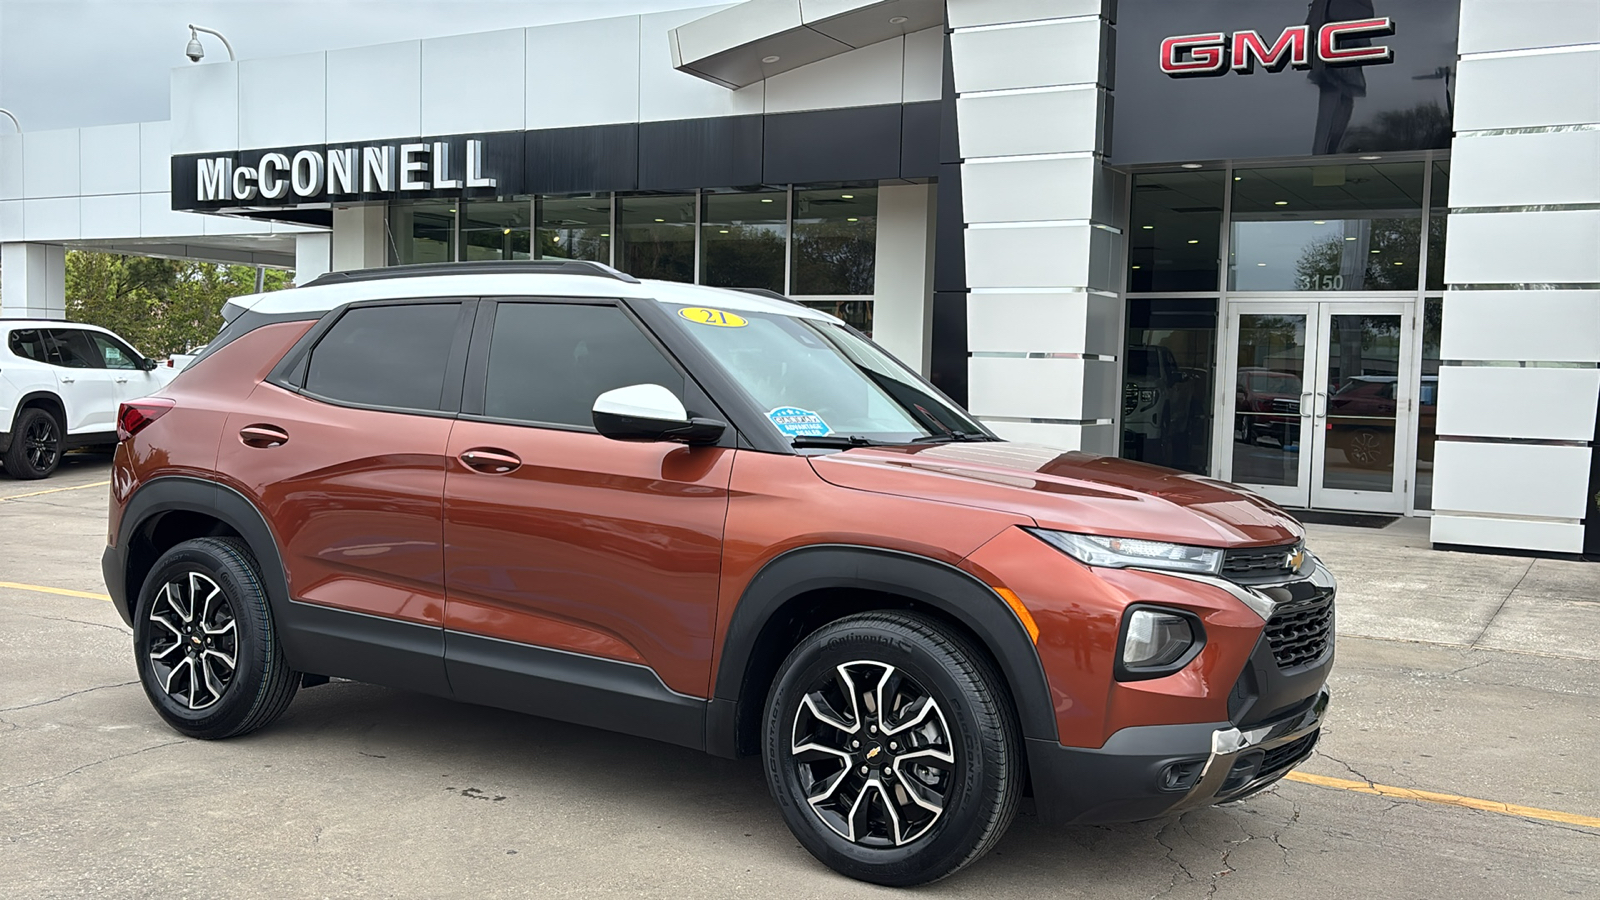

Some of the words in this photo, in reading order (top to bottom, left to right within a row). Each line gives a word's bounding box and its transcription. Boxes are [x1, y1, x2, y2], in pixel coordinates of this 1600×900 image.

[1160, 17, 1394, 76] GMC
[197, 139, 497, 200] McCONNELL
[1300, 275, 1343, 290] 3150
[700, 309, 730, 325] 21
[784, 423, 824, 431] ADVANTAGE
[827, 632, 894, 651] Continental
